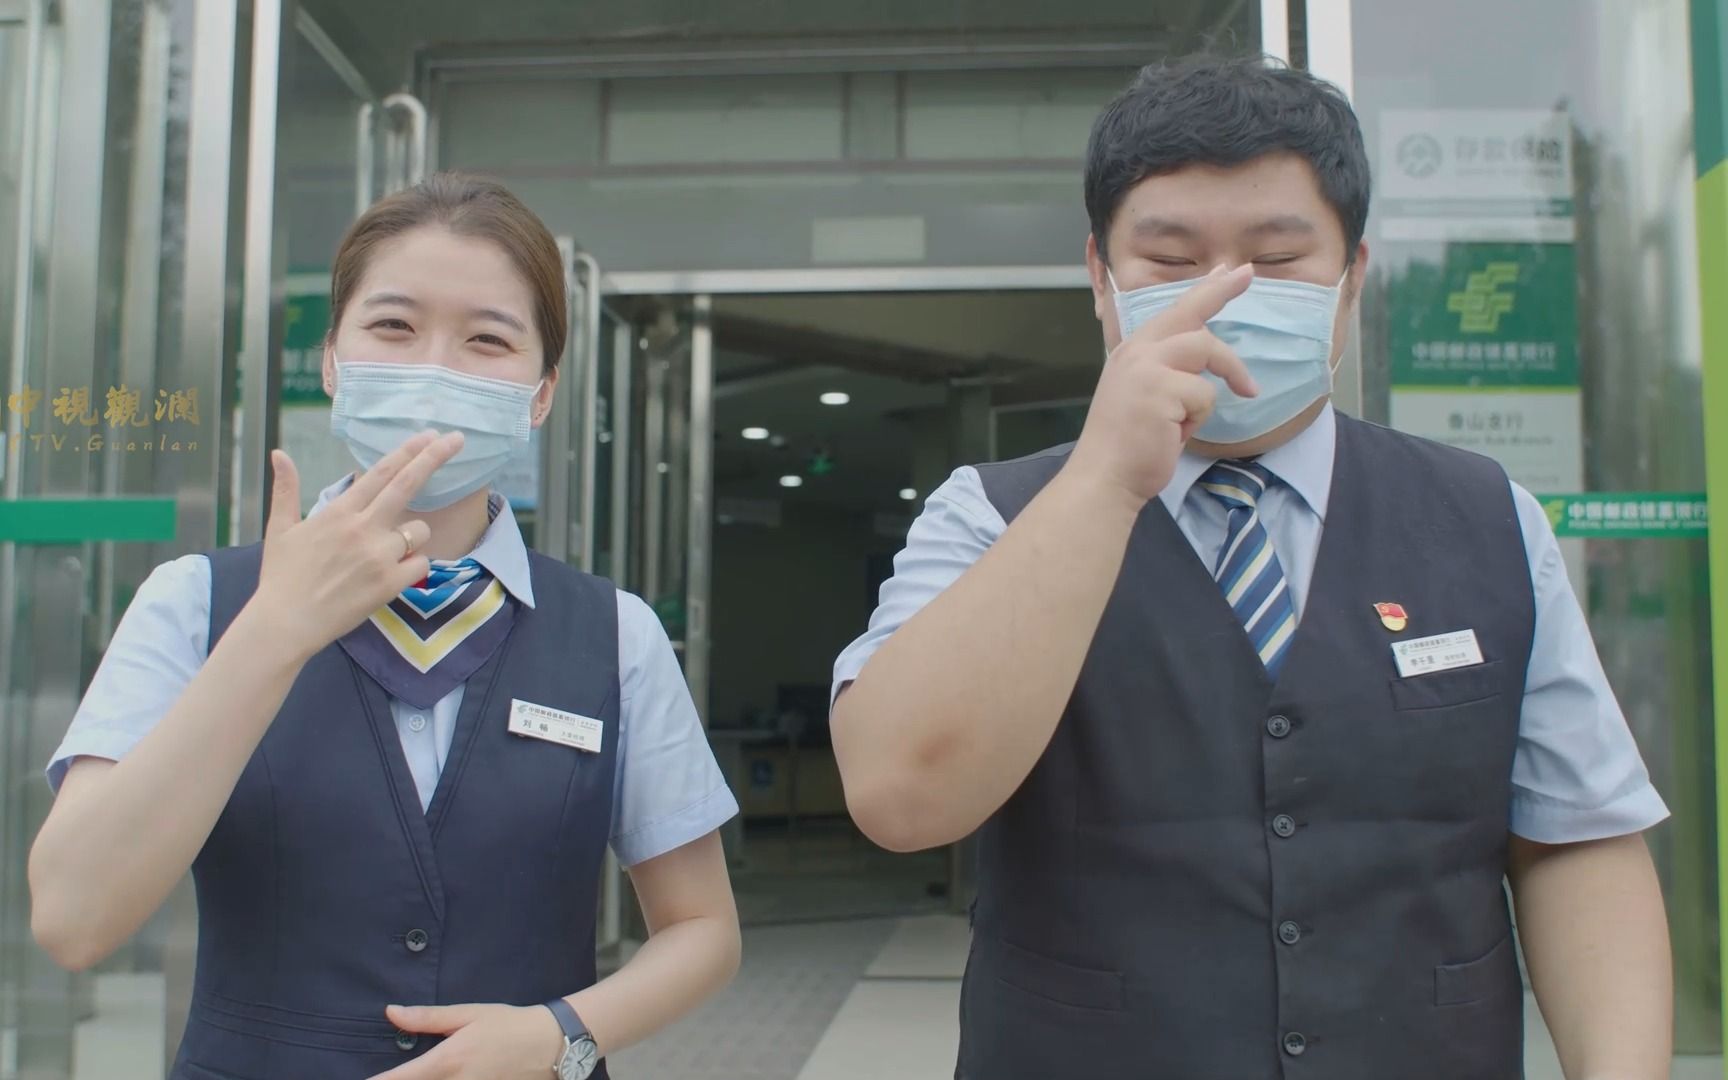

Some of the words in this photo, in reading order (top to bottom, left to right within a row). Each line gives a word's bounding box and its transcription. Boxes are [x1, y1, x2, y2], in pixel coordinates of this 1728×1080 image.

[1411, 340, 1555, 361] 中国邮政储蓄银行
[1567, 501, 1707, 519] 中国邮政储蓄银行
